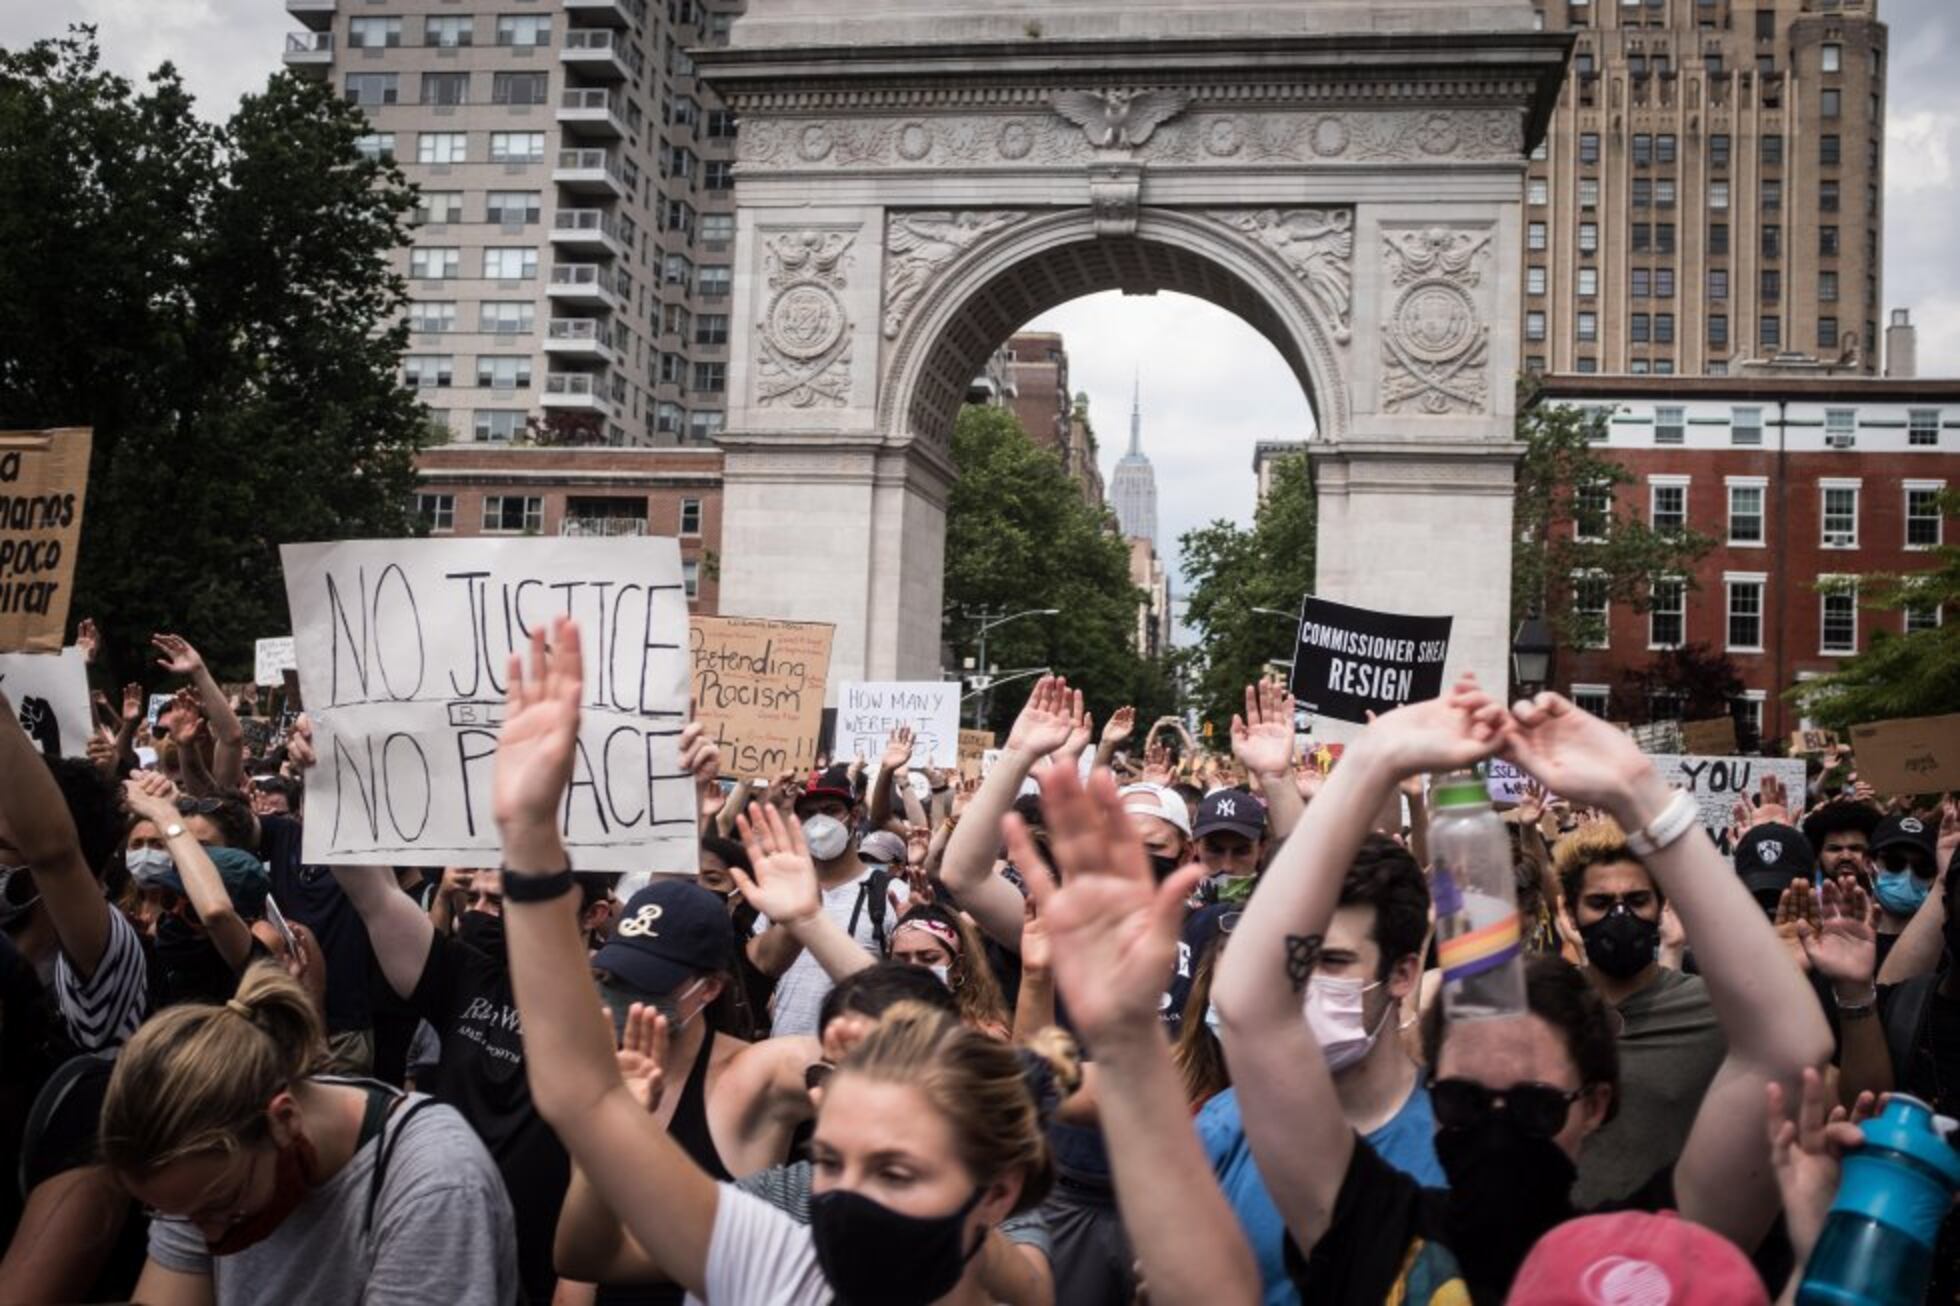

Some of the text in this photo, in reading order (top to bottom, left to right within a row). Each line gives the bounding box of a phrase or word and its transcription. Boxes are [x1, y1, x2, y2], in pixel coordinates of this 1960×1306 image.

[327, 563, 424, 706] NO
[1301, 621, 1415, 663] COMMISSIONER
[696, 669, 801, 712] Racism
[849, 687, 944, 712] HOW MANY
[1327, 657, 1413, 701] RESIGN
[460, 705, 505, 723] BL
[332, 726, 696, 848] NO PACE
[1680, 760, 1751, 793] YOU
